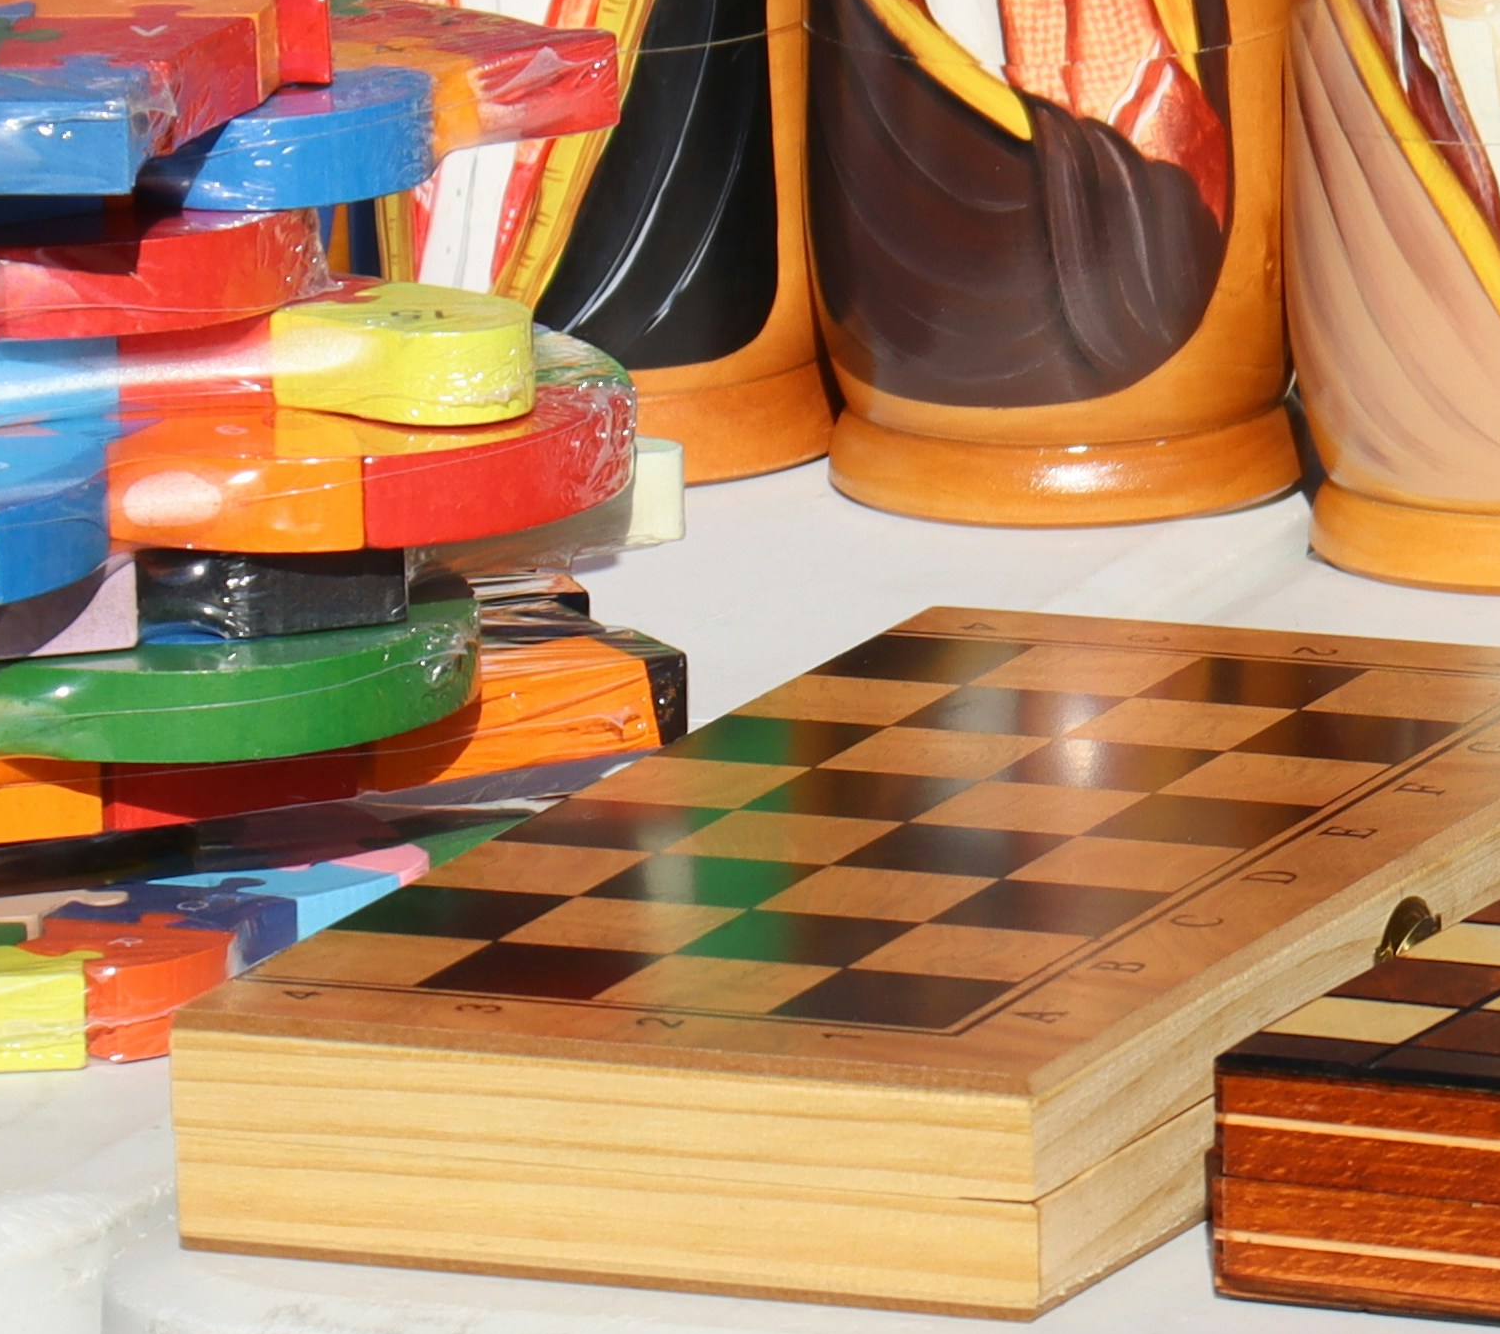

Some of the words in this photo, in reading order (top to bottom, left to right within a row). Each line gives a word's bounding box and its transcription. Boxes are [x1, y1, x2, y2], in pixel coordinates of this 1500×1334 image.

[129, 24, 168, 38] V
[957, 621, 997, 632] 4
[1126, 633, 1171, 644] 3
[1291, 645, 1338, 657] 2
[1012, 1010, 1069, 1025] A
[1090, 959, 1146, 974] B
[1170, 913, 1224, 928] C
[1239, 870, 1297, 885] D
[1317, 825, 1379, 840] E
[1392, 781, 1447, 796] F
[282, 989, 324, 1001] 4
[454, 1002, 504, 1015] 3
[634, 1016, 686, 1030] 2
